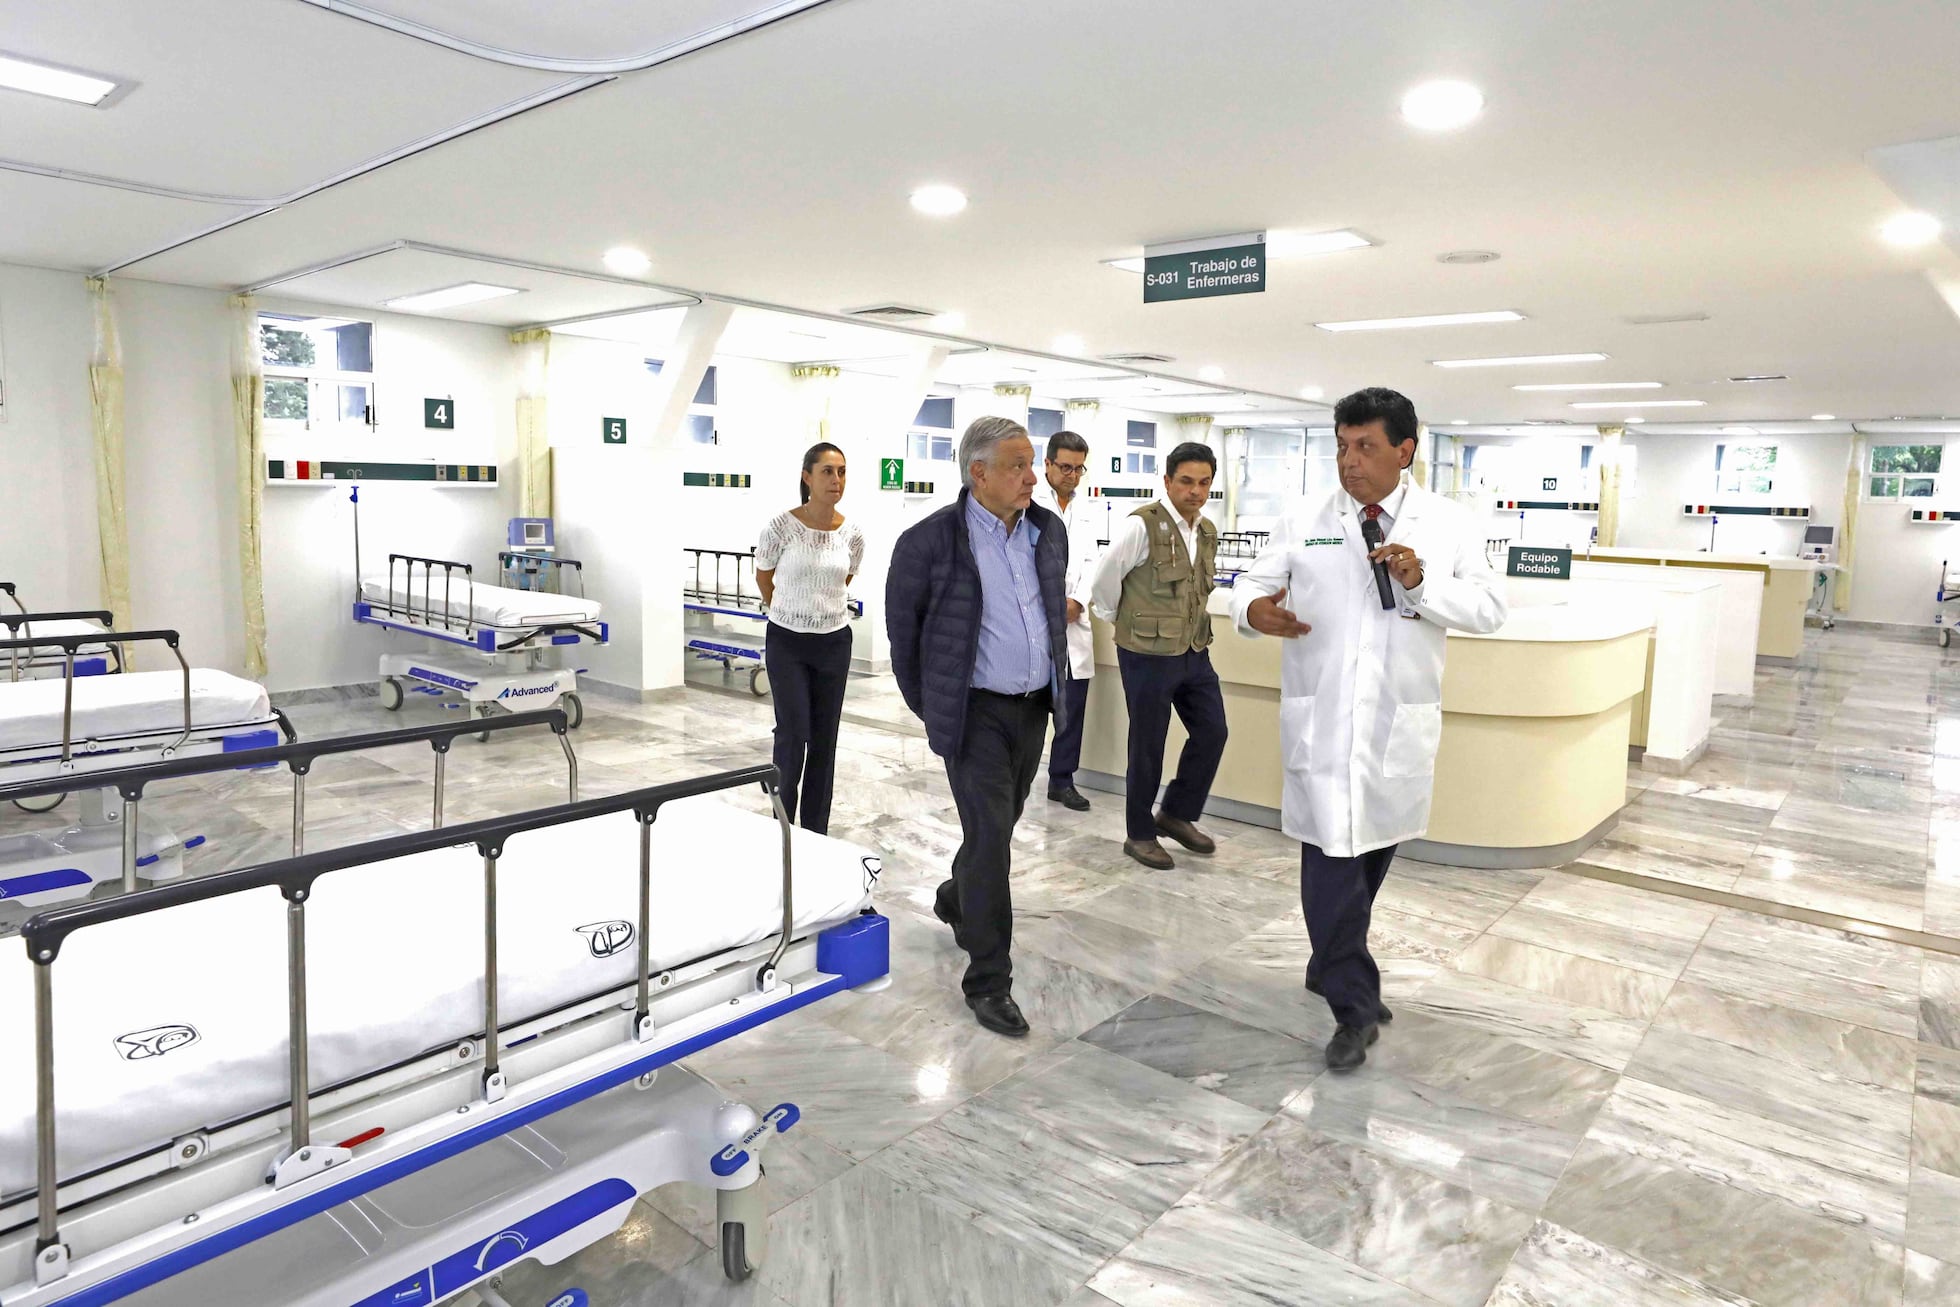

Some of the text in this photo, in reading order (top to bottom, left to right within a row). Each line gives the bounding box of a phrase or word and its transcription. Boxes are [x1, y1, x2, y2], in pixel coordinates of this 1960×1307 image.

[1190, 256, 1257, 274] Trabajo de
[1146, 272, 1179, 286] S-031
[1187, 272, 1260, 289] Enfermeras
[434, 404, 447, 424] 4
[610, 422, 622, 440] 5
[1113, 460, 1120, 471] 8
[1543, 480, 1556, 490] 10
[1520, 552, 1559, 563] Equipo
[1516, 563, 1561, 574] Rodable
[725, 1148, 737, 1159] OFF
[743, 1124, 768, 1145] BRAKE
